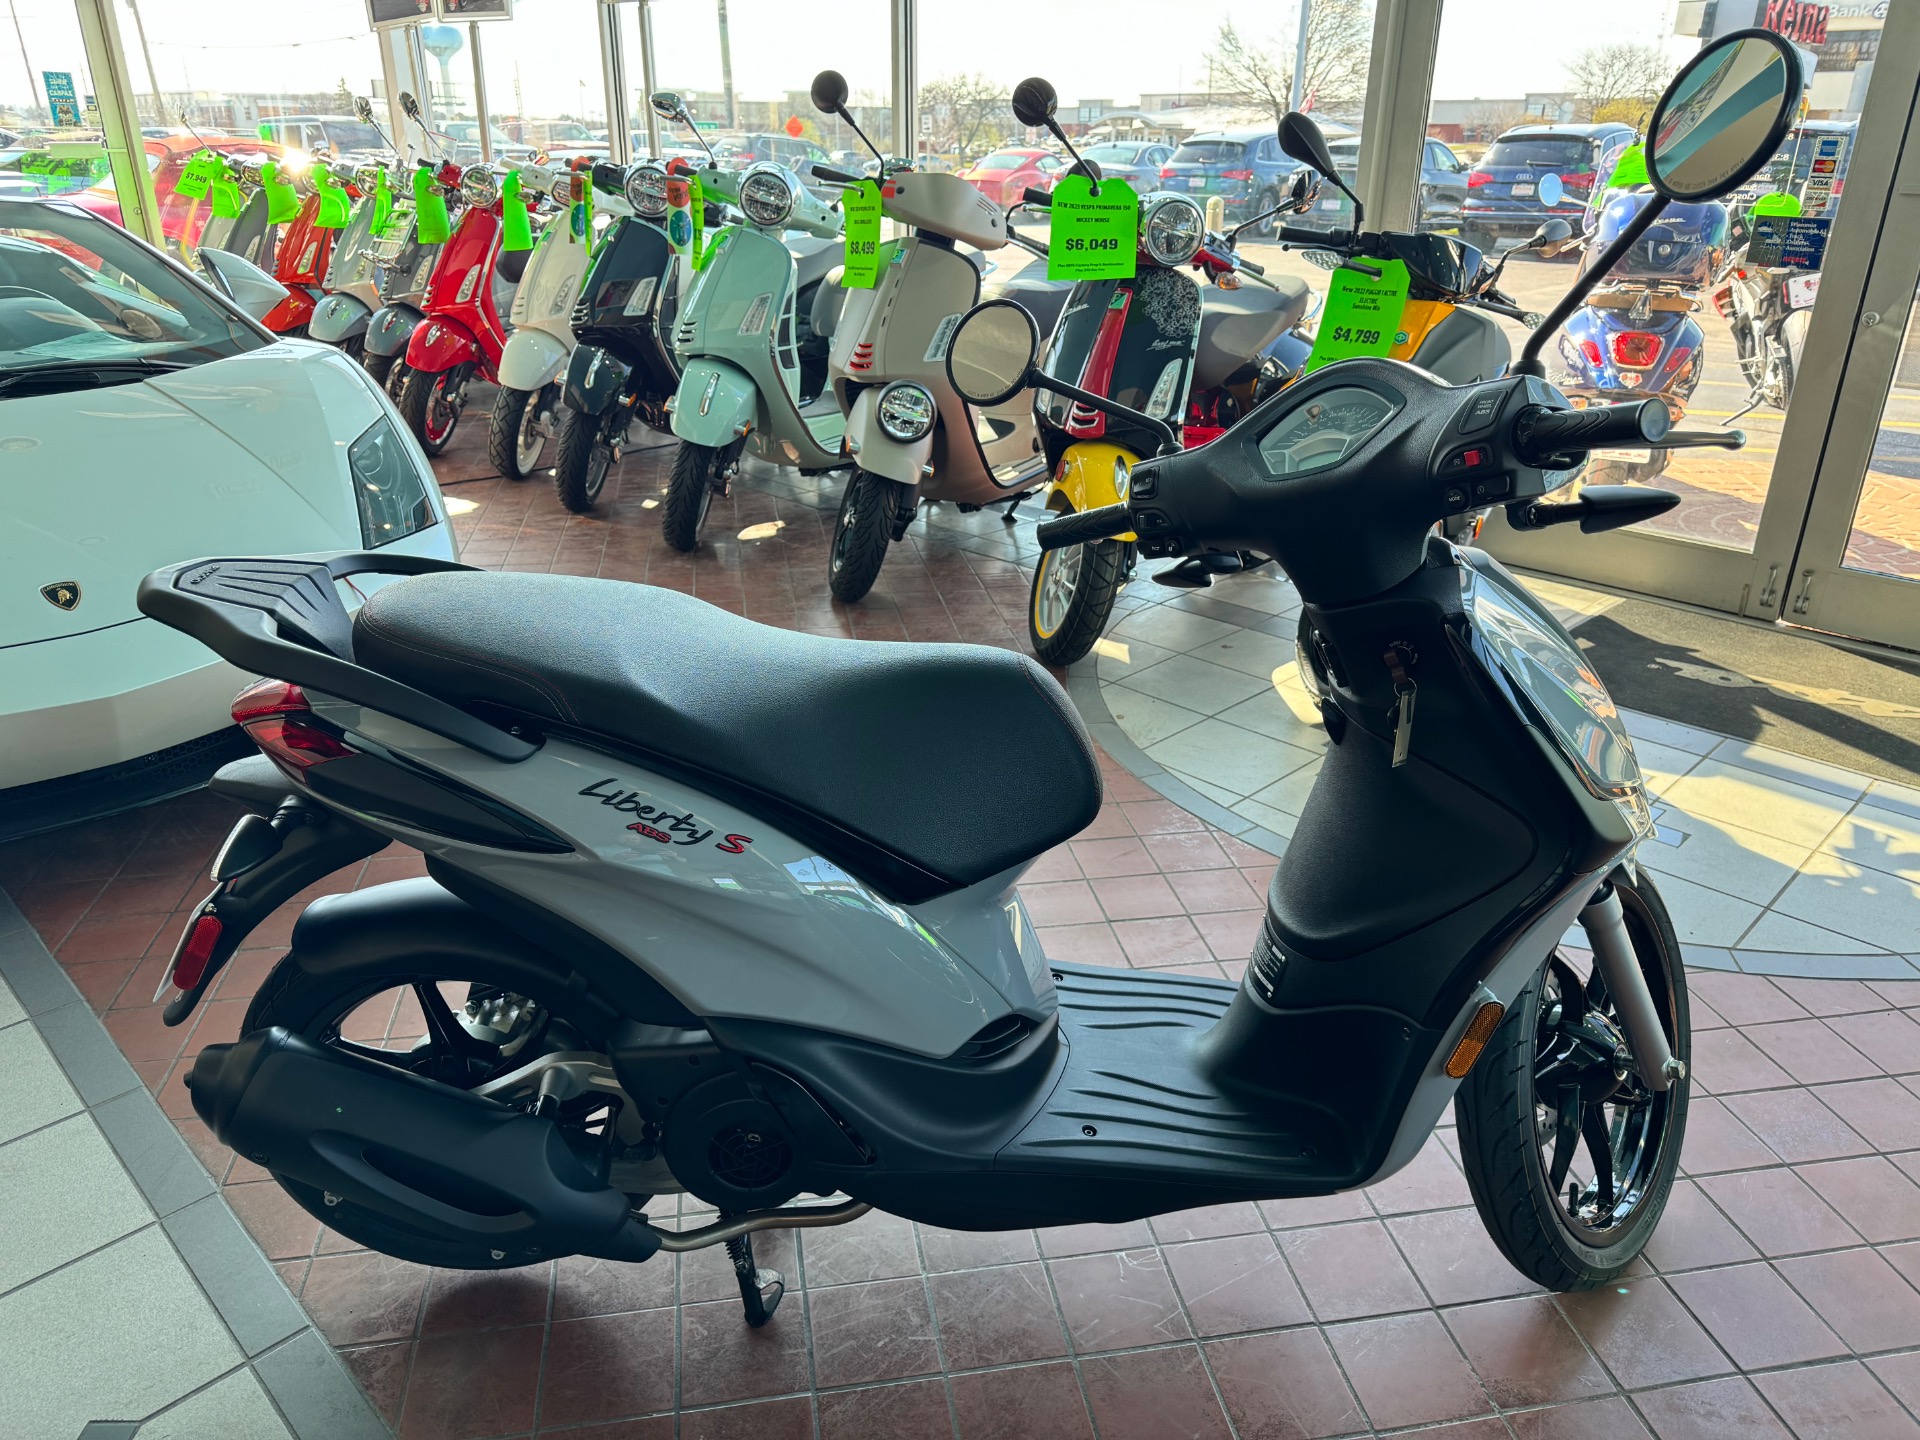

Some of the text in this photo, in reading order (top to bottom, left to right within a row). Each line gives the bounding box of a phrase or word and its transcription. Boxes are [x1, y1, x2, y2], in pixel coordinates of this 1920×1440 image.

[1829, 4, 1871, 18] Bank
[850, 241, 875, 256] $8,499
[1065, 238, 1118, 252] $6,049
[1333, 326, 1380, 344] $4,799
[578, 778, 753, 854] Liberty S
[626, 822, 672, 843] ABS
